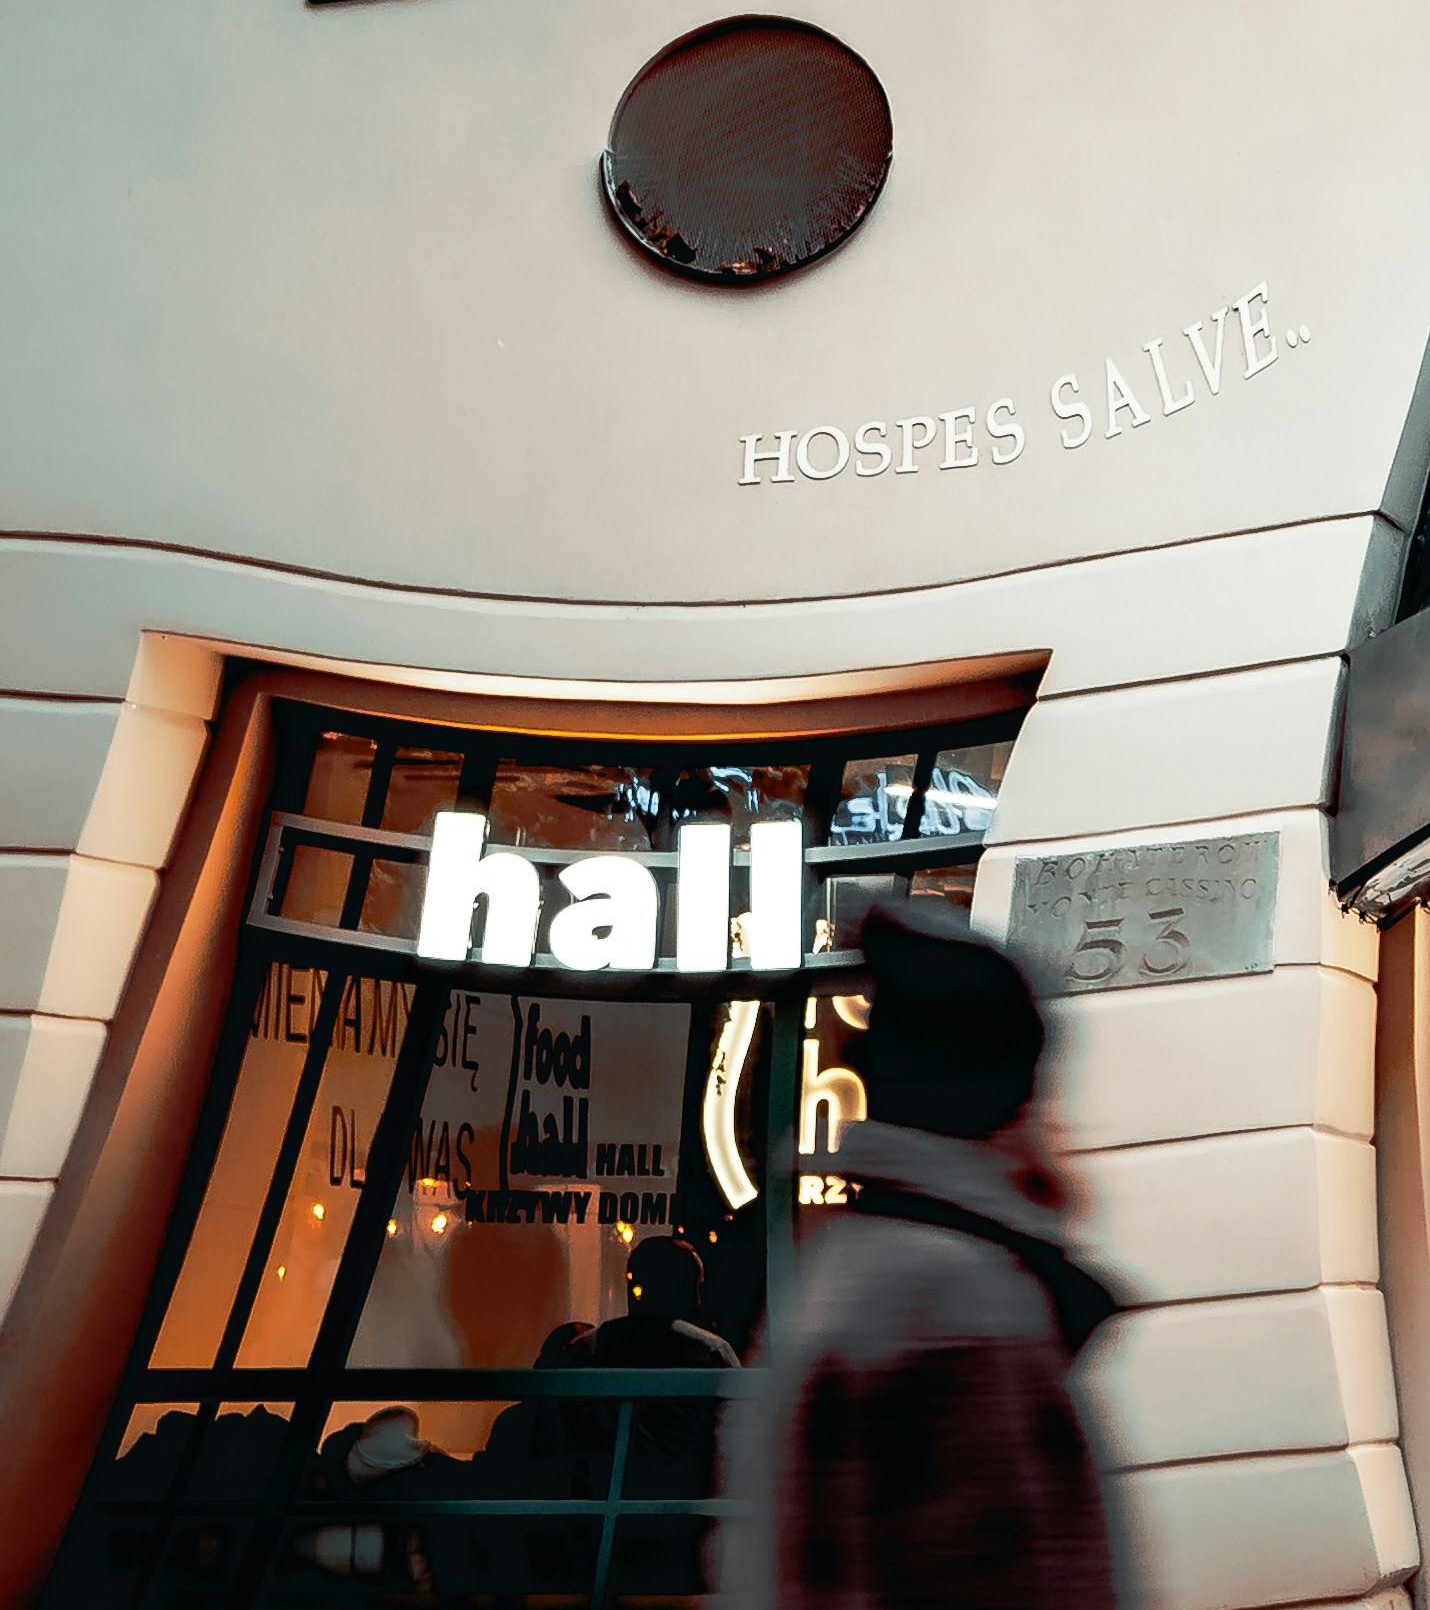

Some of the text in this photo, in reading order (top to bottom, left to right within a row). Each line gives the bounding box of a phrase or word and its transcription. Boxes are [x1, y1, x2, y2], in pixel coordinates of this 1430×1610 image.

[737, 397, 1026, 485] HOSPES
[417, 811, 803, 973] hall
[1066, 907, 1193, 981] 53
[523, 1002, 591, 1090] food
[595, 1142, 665, 1177] HALL
